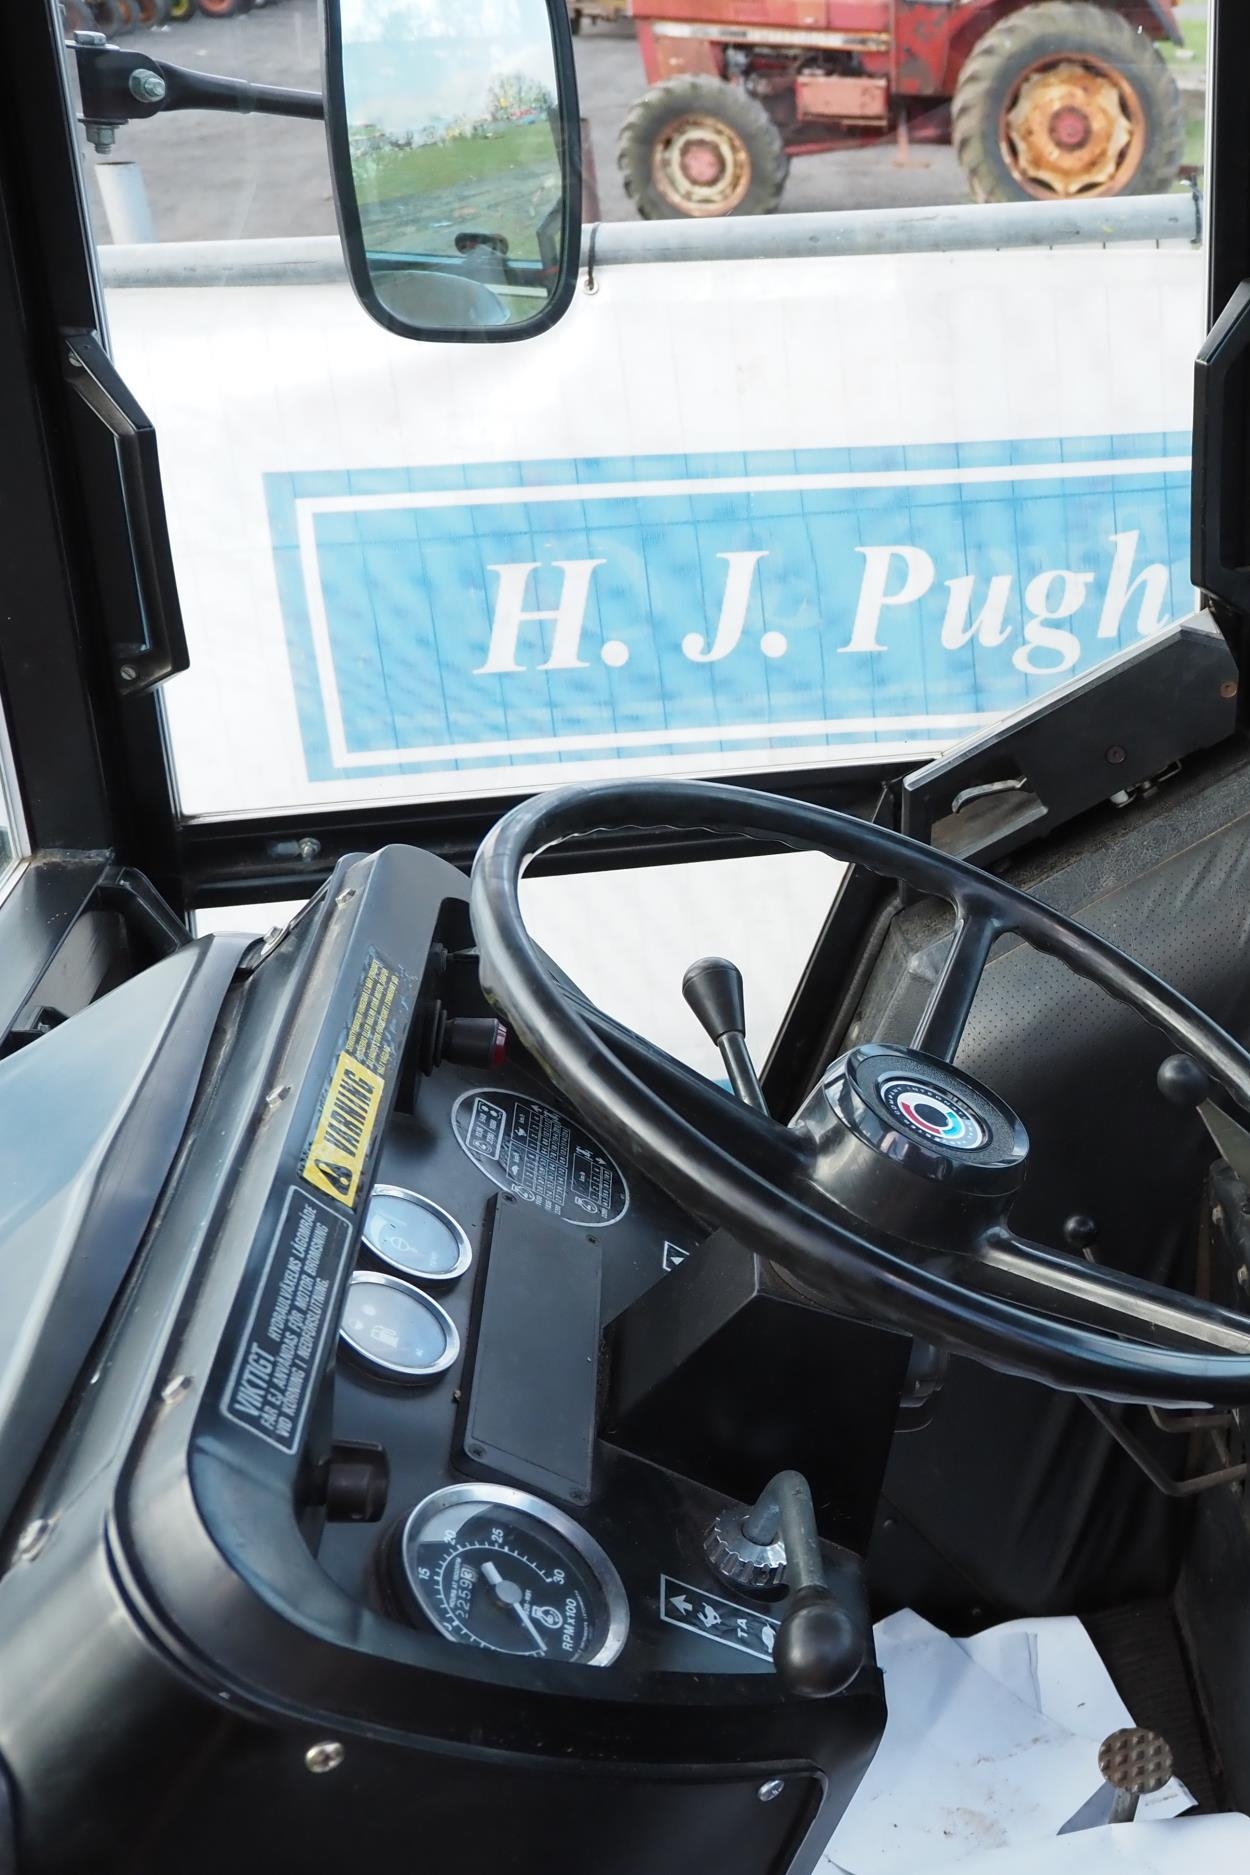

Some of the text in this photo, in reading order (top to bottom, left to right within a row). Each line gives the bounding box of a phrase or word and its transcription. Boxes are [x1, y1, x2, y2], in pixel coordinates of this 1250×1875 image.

[472, 558, 629, 675] H.
[681, 551, 788, 663] J.
[837, 529, 1170, 675] Pugh
[324, 1068, 374, 1157] VARNING
[234, 1342, 274, 1415] VIKTIGT
[290, 1203, 316, 1257] LÅGOMRÅDE
[272, 1331, 298, 1389] ANVÄNDAS
[294, 1274, 313, 1310] MOTOR
[304, 1222, 328, 1275] BROMSNING
[281, 1367, 305, 1416] KÖRNING
[276, 1416, 292, 1437] VID
[443, 1529, 457, 1546] 20
[491, 1528, 504, 1543] 25
[417, 1566, 430, 1580] 15
[553, 1569, 565, 1584] 30
[736, 1618, 749, 1638] TA
